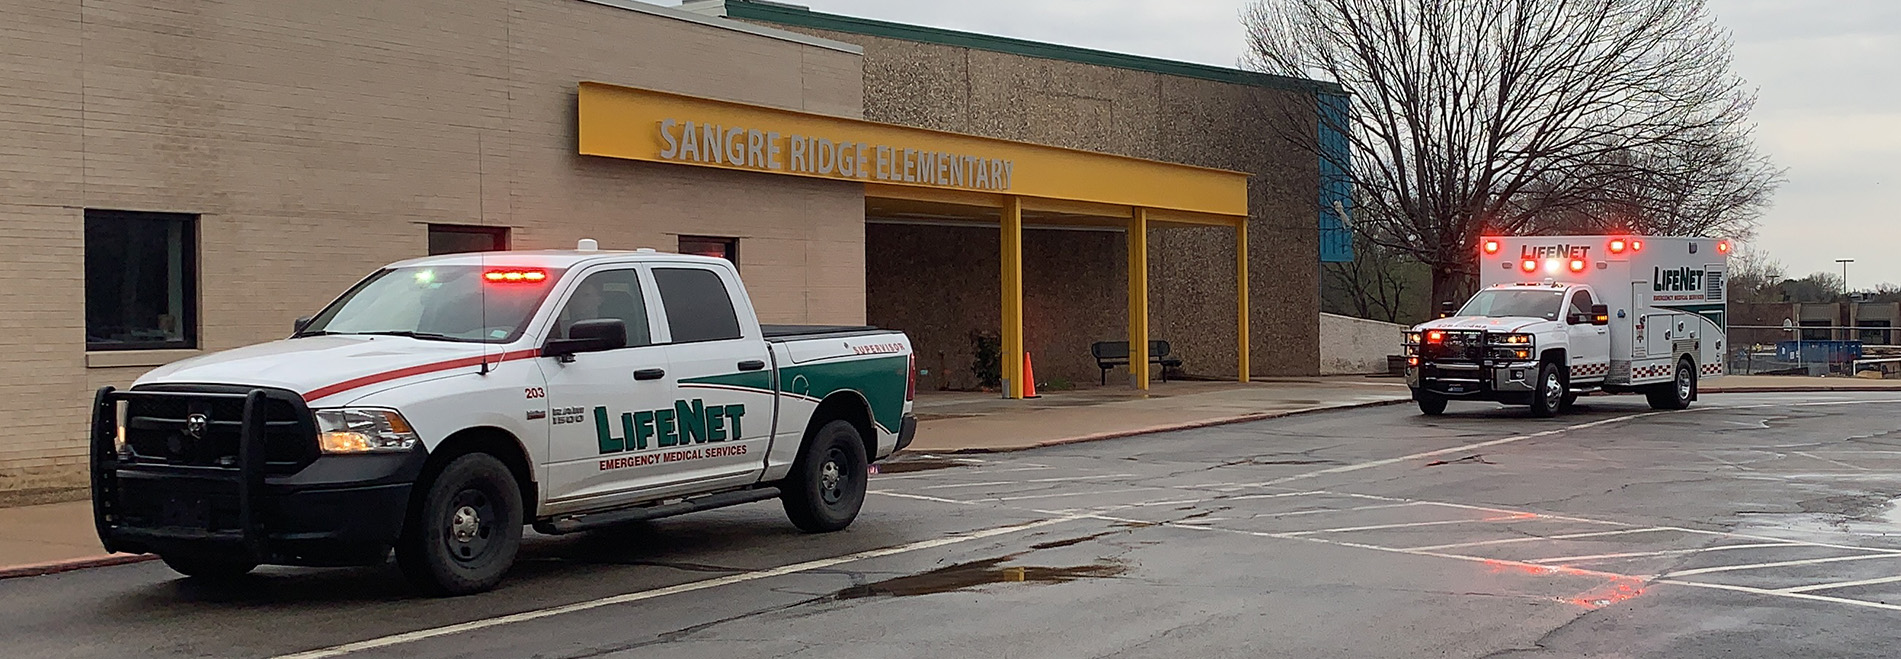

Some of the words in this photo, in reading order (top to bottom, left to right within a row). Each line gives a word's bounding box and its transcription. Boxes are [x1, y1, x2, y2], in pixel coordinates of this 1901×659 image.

[659, 118, 782, 170] SANGRE
[789, 134, 868, 179] RIDGE
[875, 144, 1015, 191] ELEMENTARY
[1653, 266, 1704, 292] LIFENET
[852, 342, 905, 354] SUPERVISOR
[525, 387, 545, 399] 203
[552, 406, 585, 416] RAM
[552, 414, 585, 425] 1500
[593, 399, 746, 454] LIFENET
[599, 453, 660, 471] EMERGENCY
[663, 448, 703, 463] MEDICAL
[705, 444, 747, 459] SERVICES
